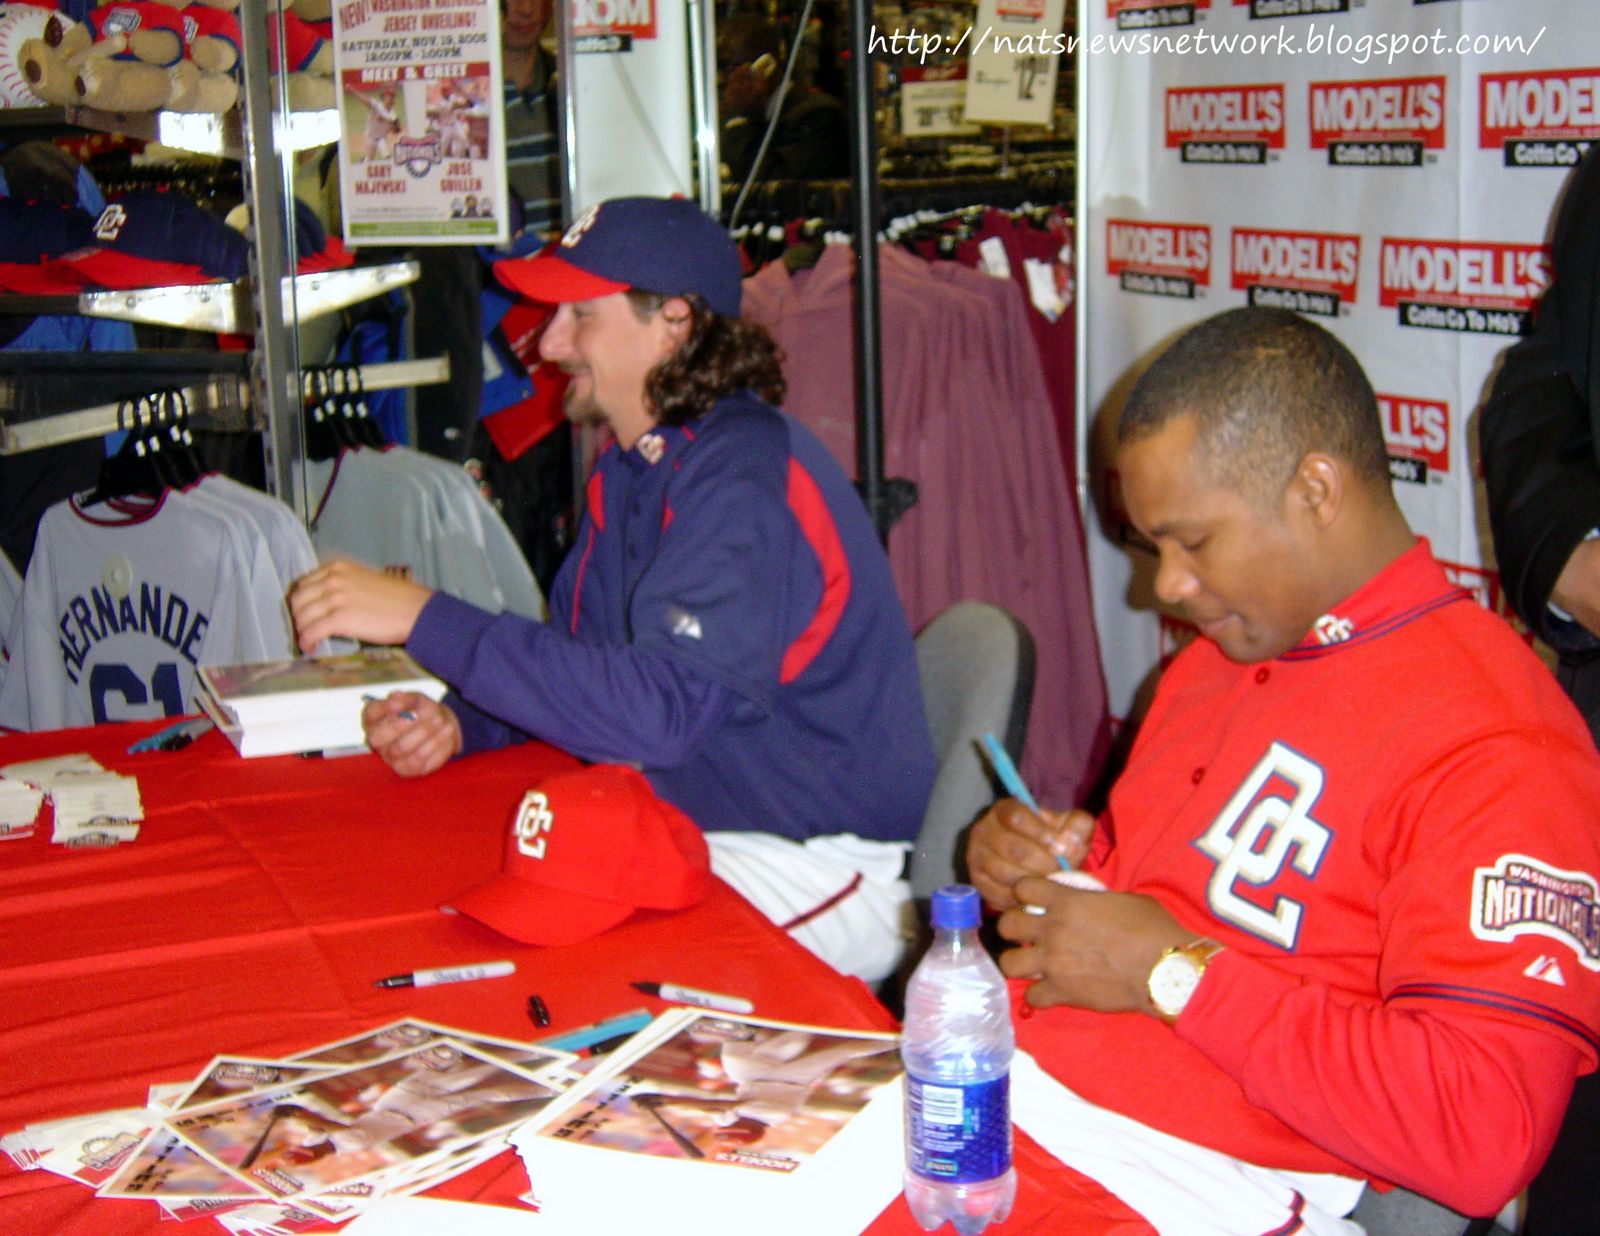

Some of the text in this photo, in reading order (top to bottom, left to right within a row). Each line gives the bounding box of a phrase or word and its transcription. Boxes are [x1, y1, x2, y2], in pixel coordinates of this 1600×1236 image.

[384, 15, 418, 32] JERSEY
[362, 63, 467, 82] MEET & GREET
[1168, 89, 1282, 133] MODELL'S
[1313, 82, 1442, 130] MODELL'S
[447, 161, 472, 176] JOSE
[1234, 233, 1358, 285] MODELL'S
[1383, 243, 1549, 300] MODELL'S
[59, 582, 209, 685] HERNANDE
